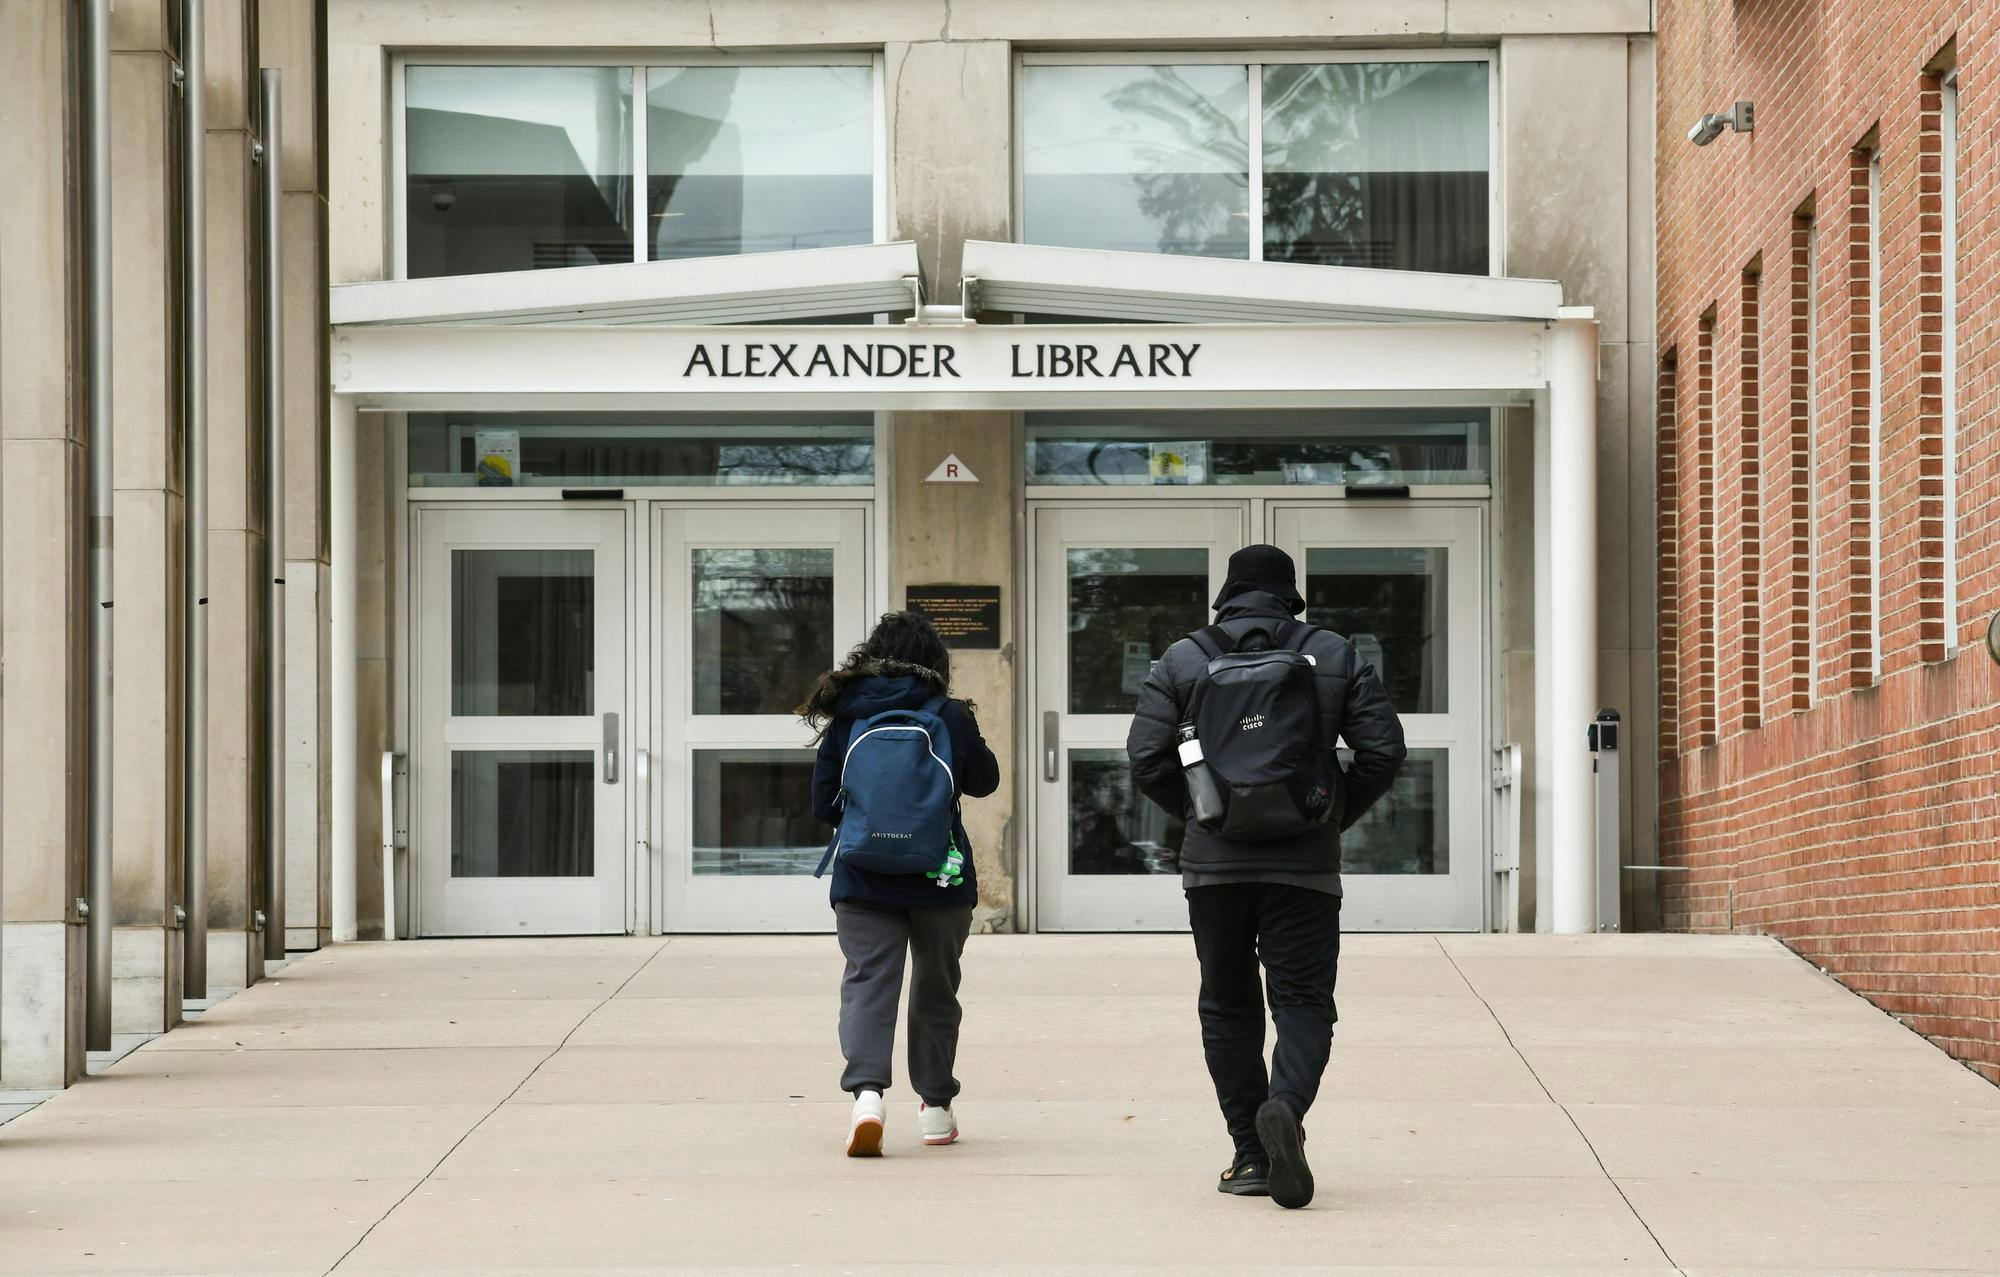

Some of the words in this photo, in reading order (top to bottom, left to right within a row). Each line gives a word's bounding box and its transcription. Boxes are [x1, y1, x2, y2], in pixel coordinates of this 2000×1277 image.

[683, 343, 961, 378] ALEXANDER
[1012, 343, 1202, 378] LIBRARY
[946, 464, 958, 478] R
